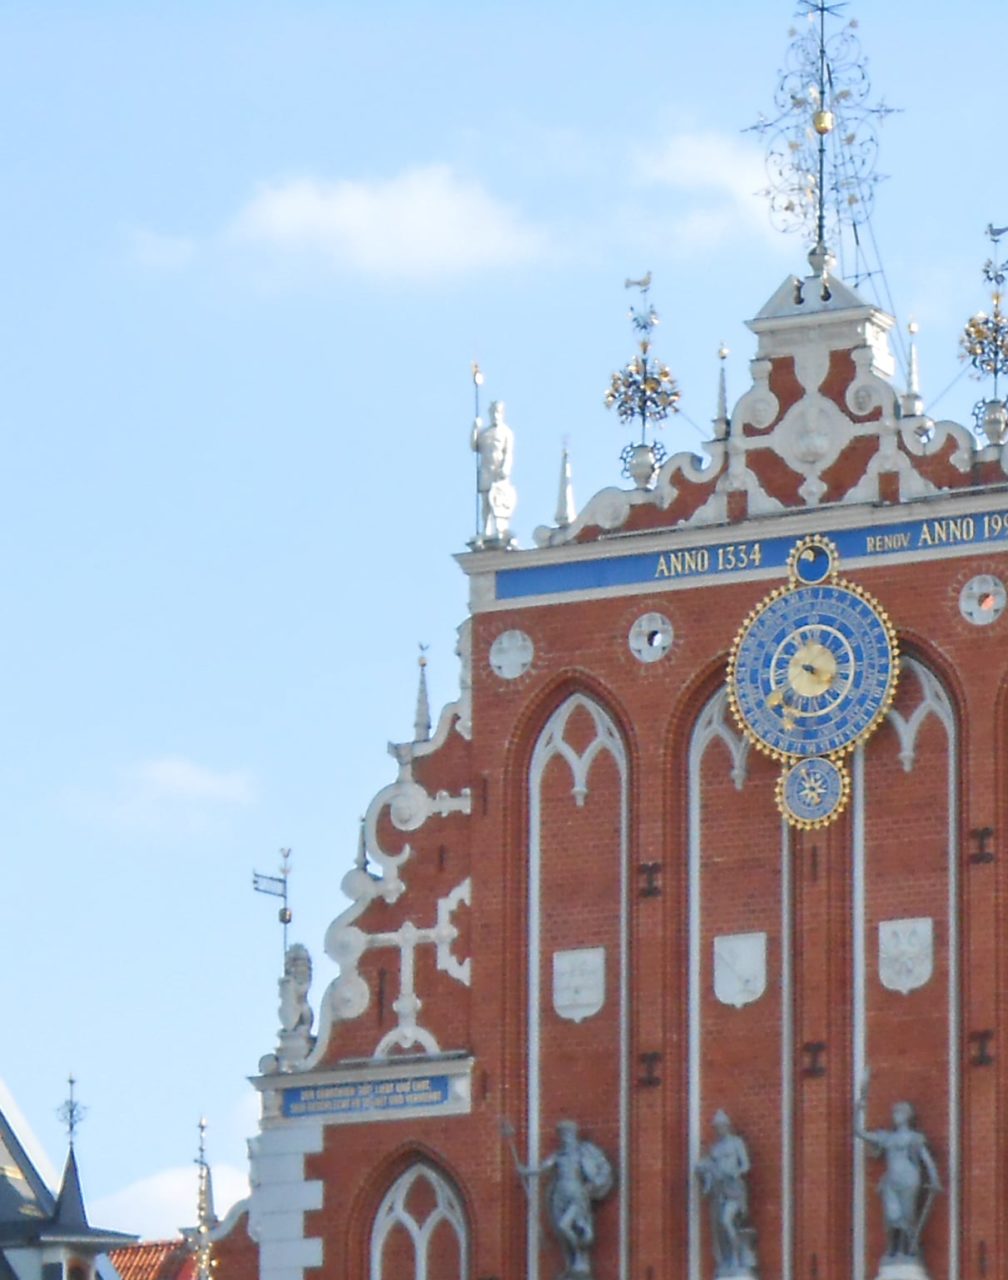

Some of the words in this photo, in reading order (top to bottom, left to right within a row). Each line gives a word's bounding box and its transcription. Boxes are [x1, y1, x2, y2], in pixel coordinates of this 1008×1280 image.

[918, 518, 974, 546] ANNO
[655, 549, 709, 577] ANNO
[718, 543, 761, 570] 1334
